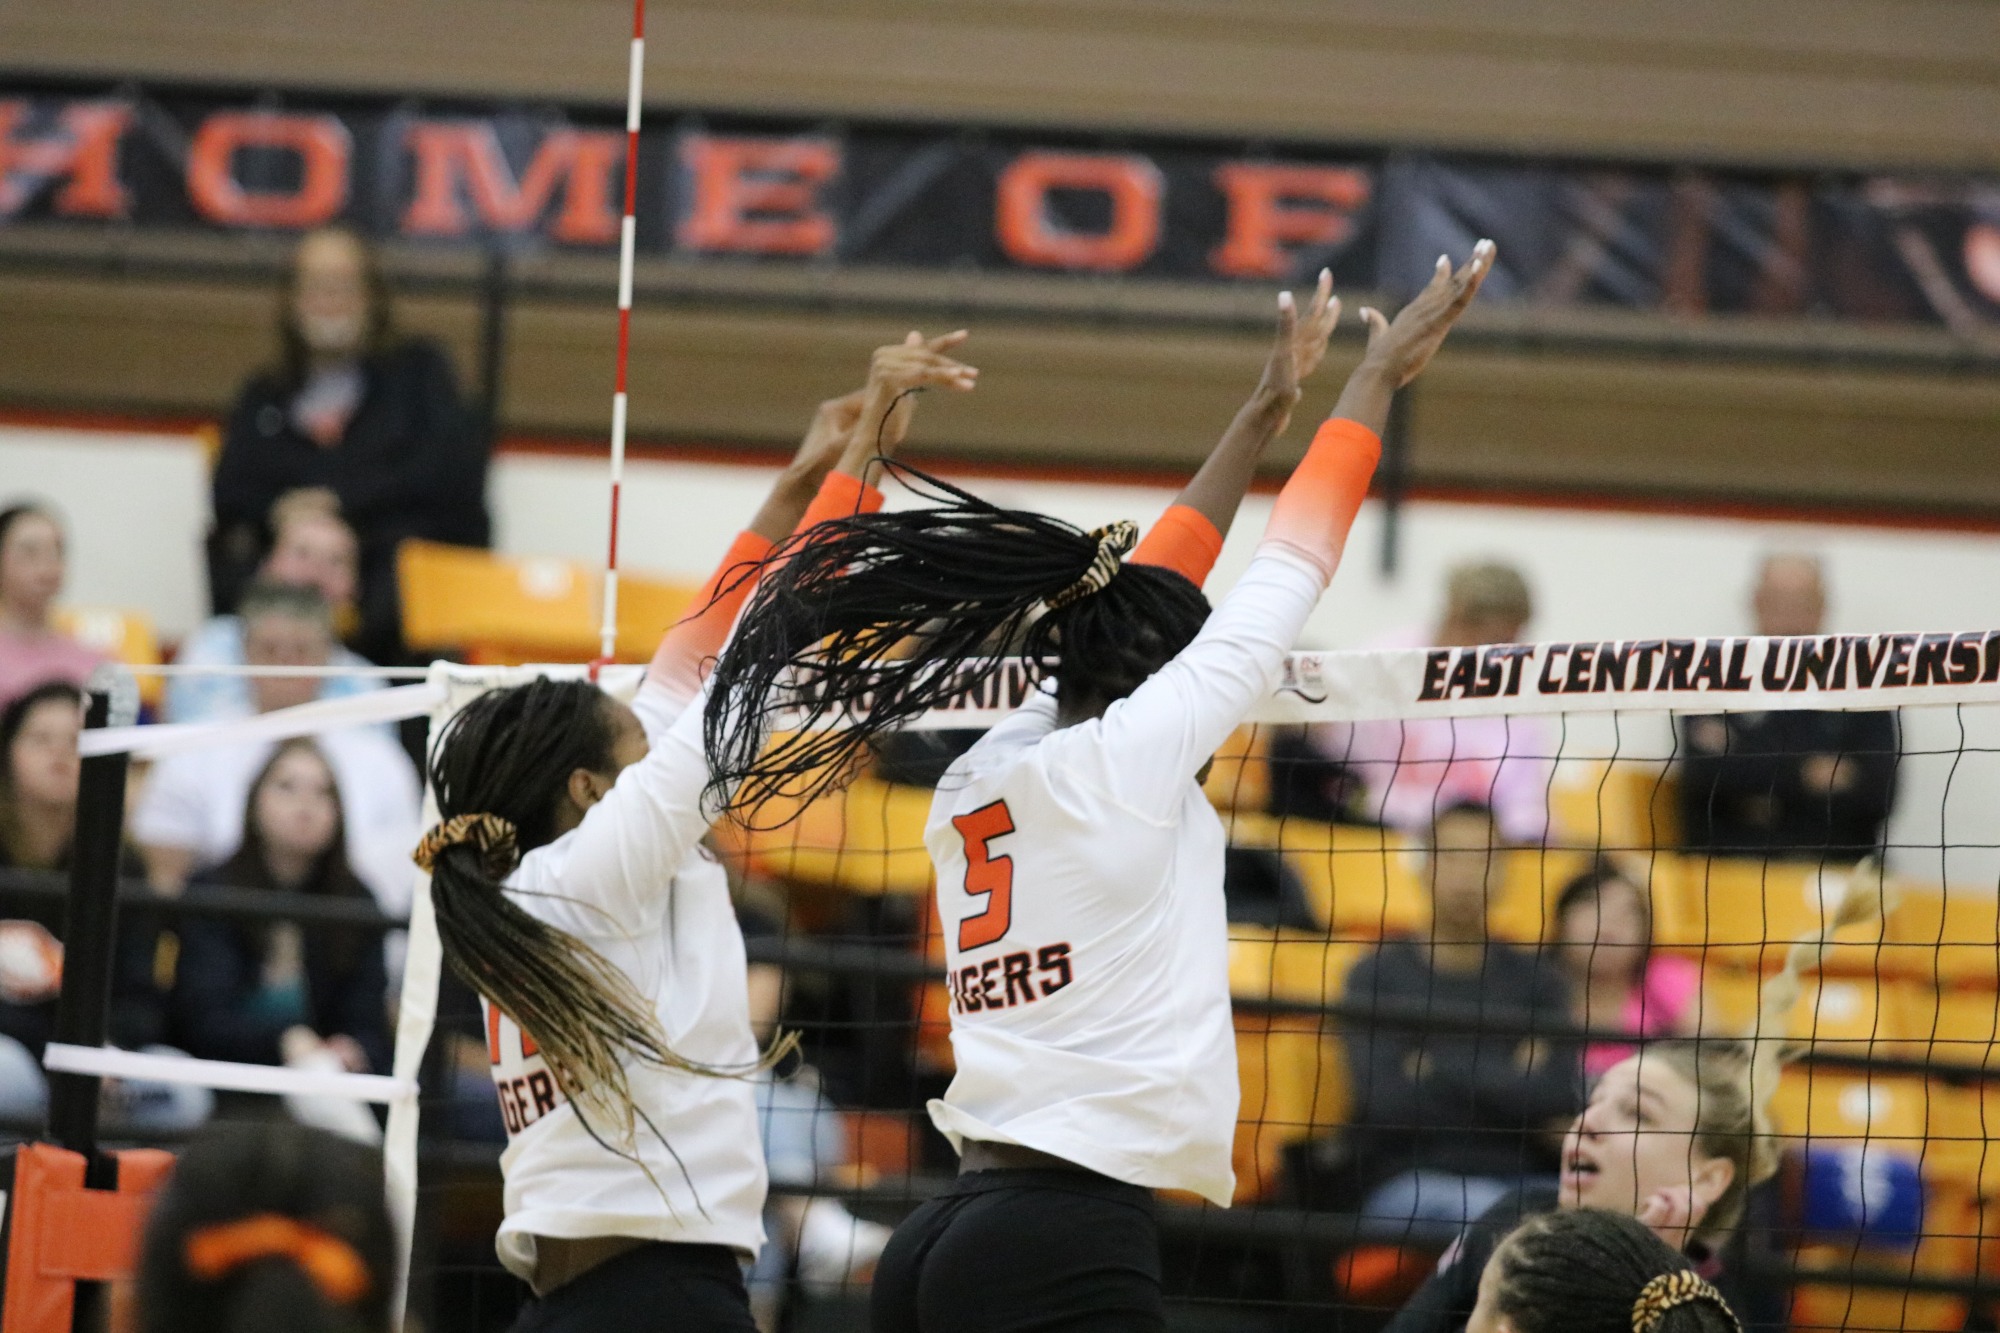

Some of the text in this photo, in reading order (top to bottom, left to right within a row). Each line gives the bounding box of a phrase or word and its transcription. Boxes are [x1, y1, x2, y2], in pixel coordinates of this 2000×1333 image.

[0, 98, 1371, 277] HOME OF
[1416, 645, 1536, 702] EAST
[1537, 637, 1753, 694] CENTRAL
[952, 797, 1016, 954] 5
[948, 941, 1074, 1015] IGERS
